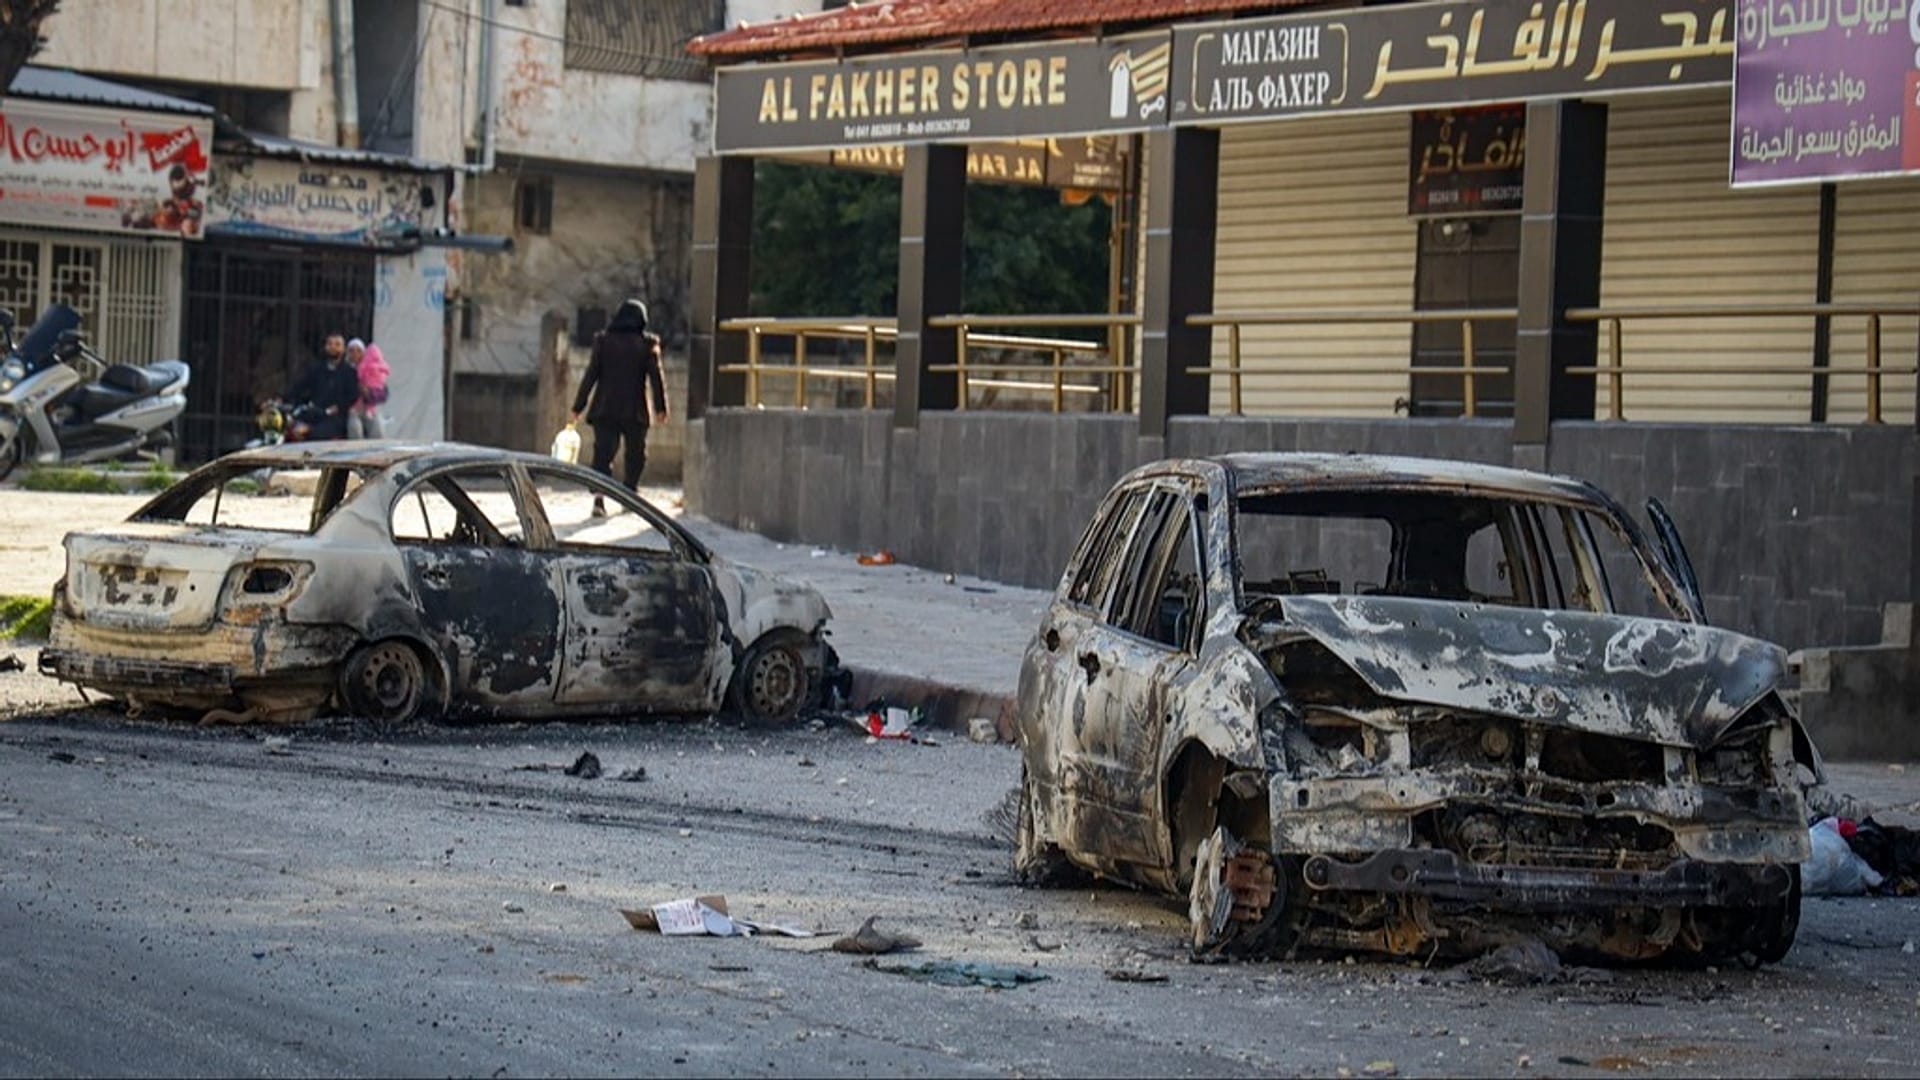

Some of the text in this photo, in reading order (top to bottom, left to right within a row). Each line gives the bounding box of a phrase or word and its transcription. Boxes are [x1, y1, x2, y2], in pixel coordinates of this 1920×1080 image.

[1222, 26, 1321, 65] МАГАЗИН
[759, 56, 1067, 122] AL FAKHER STORE
[1209, 72, 1330, 112] АЛЬ ФАХЕР
[1775, 70, 1865, 112] مواد غذائية
[23, 127, 101, 161] حسن
[104, 117, 134, 173] أبو
[1740, 114, 1900, 163] المفرق بسعر الجملة
